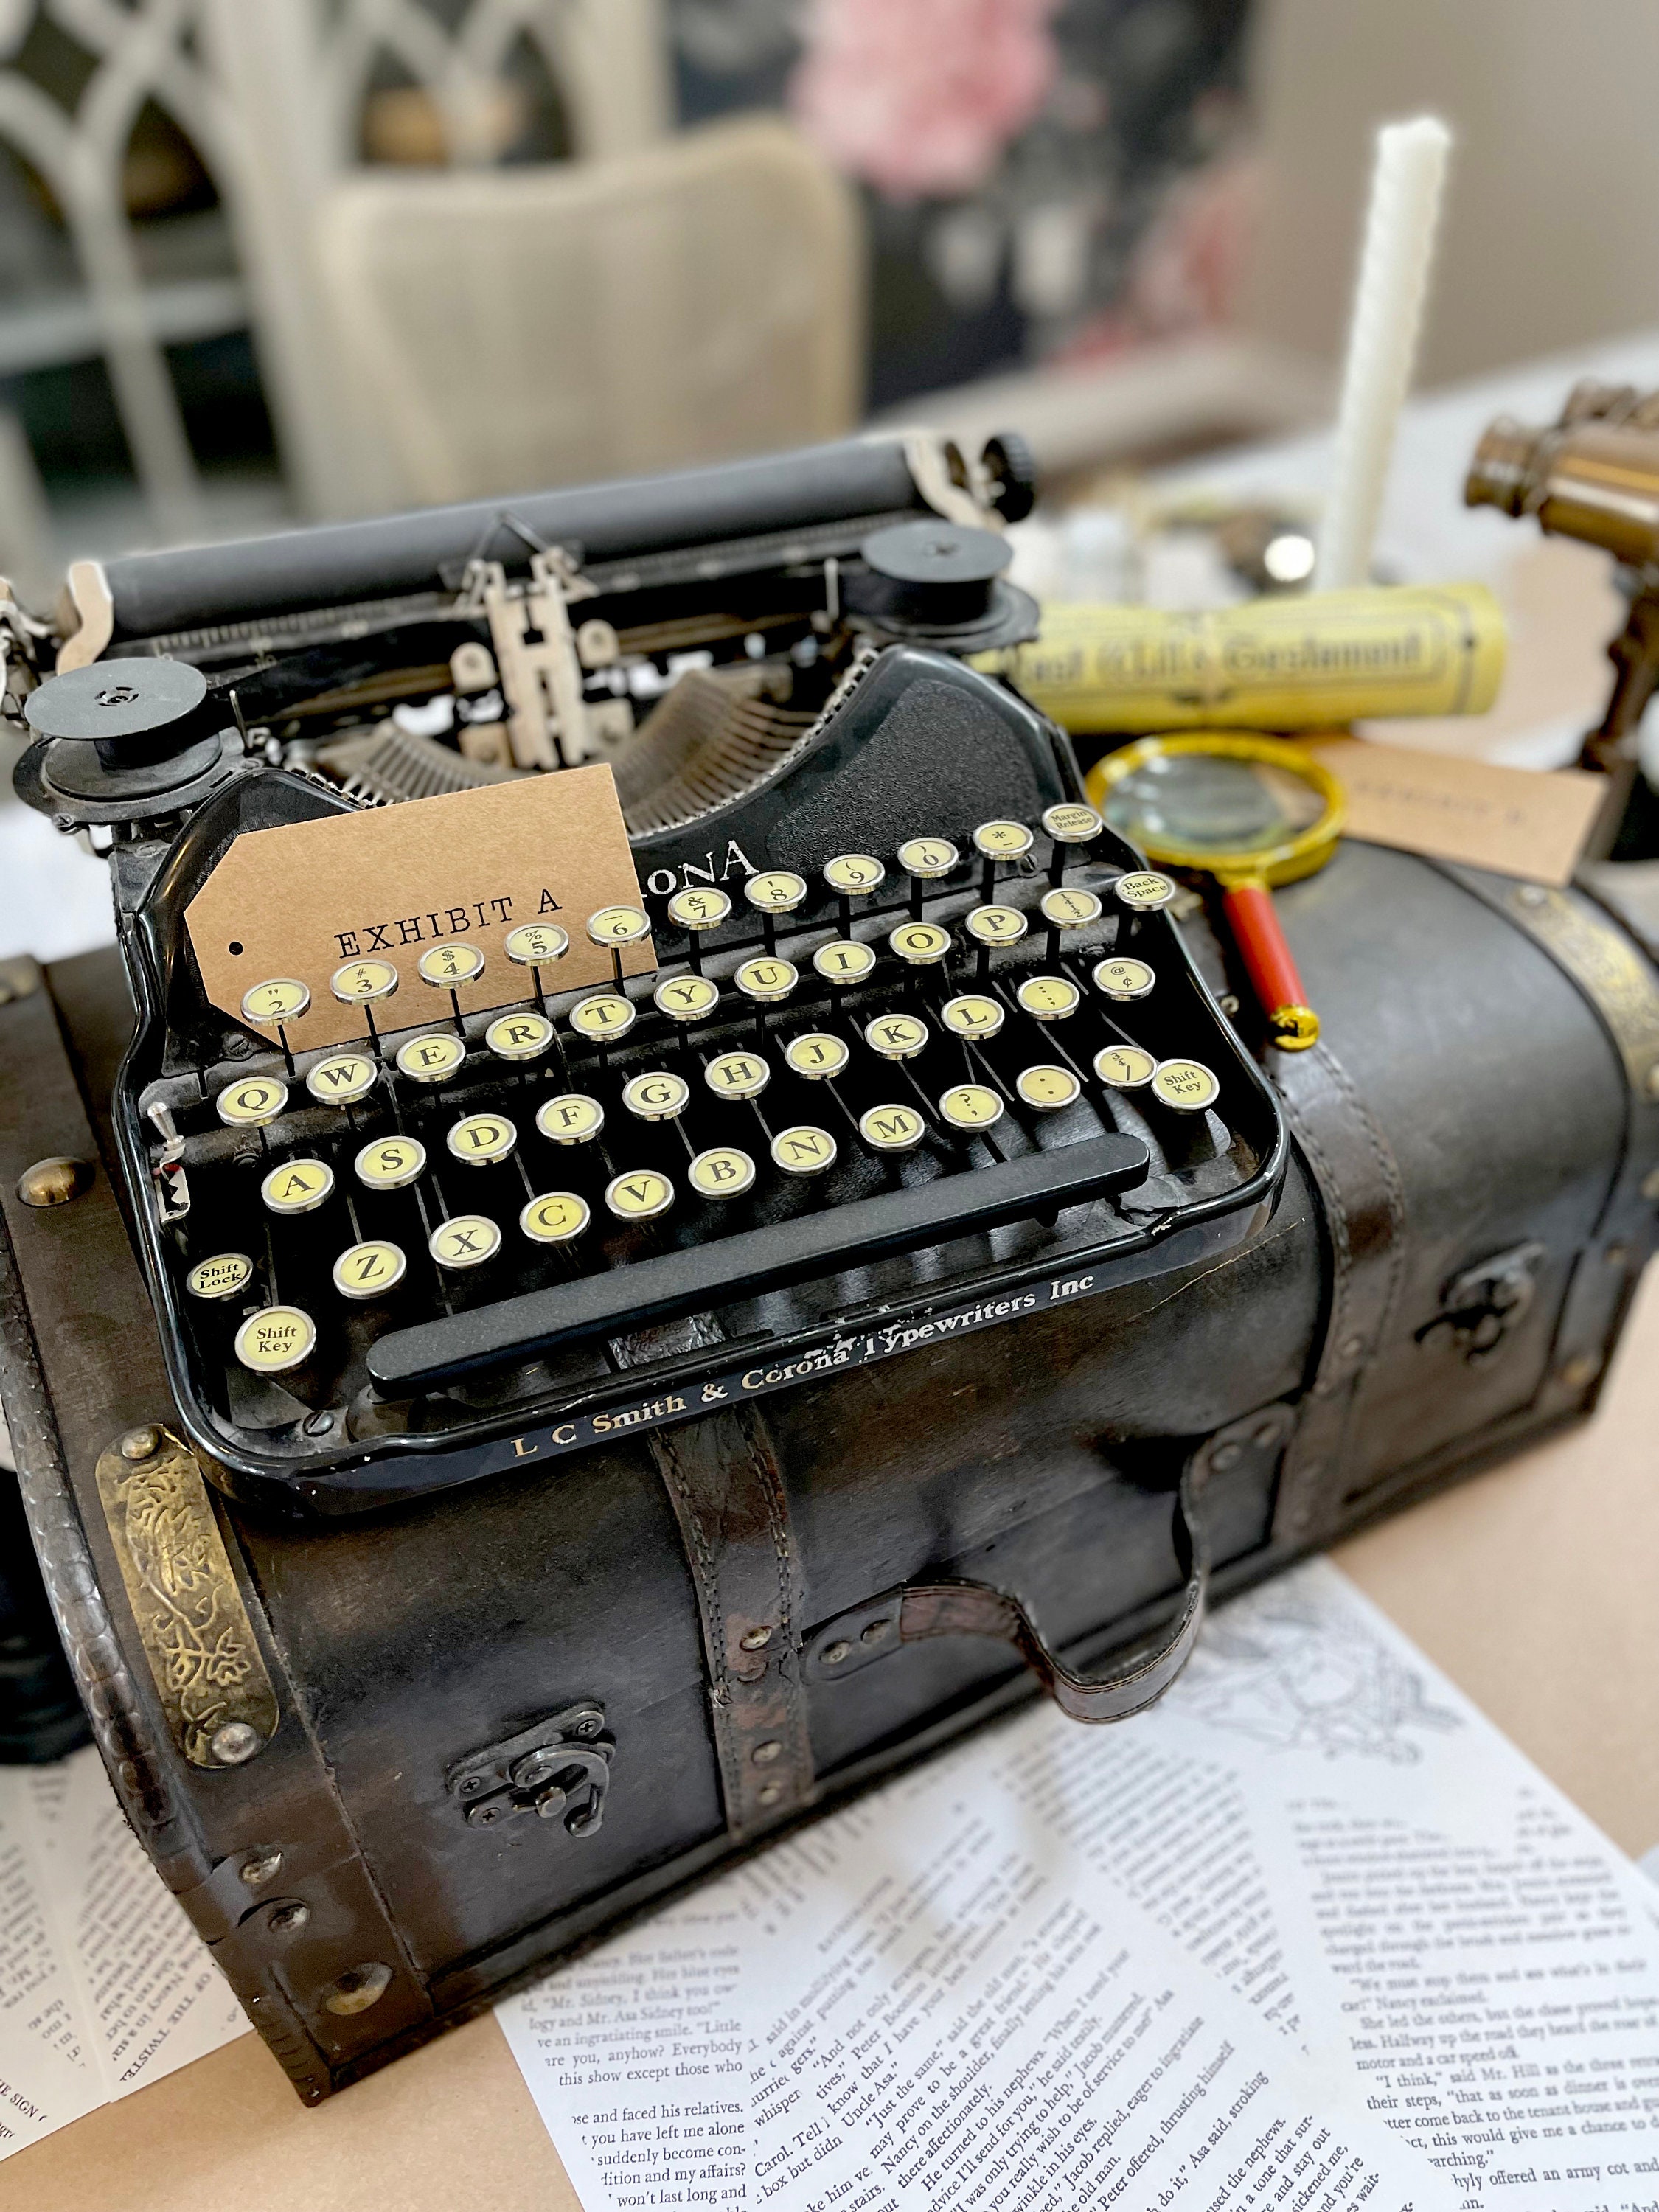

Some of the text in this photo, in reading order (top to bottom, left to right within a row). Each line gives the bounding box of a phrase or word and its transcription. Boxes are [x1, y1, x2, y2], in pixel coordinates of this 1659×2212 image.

[1051, 811, 1087, 822] Margin
[1054, 817, 1093, 829] Release
[641, 839, 759, 898] ONA
[923, 854, 939, 866] 0
[849, 872, 864, 883] 9
[1123, 877, 1159, 890] Back
[771, 889, 787, 900] 8
[1127, 885, 1166, 898] Space
[692, 906, 707, 918] 7
[334, 889, 562, 959] EXHIBIT A
[612, 922, 627, 936] 6
[984, 915, 1005, 931] P
[531, 942, 547, 954] 5
[907, 933, 933, 948] O
[443, 962, 460, 975] 4
[836, 953, 851, 970] I
[1110, 966, 1125, 975] @
[358, 980, 373, 992] 3
[750, 967, 777, 984] U
[670, 985, 696, 1004] Y
[268, 1001, 286, 1014] 2
[585, 1004, 615, 1024] T
[957, 1009, 987, 1026] L
[505, 1026, 539, 1044] R
[880, 1024, 914, 1044] K
[417, 1046, 446, 1066] E
[810, 1044, 824, 1063] J
[321, 1063, 357, 1086] W
[720, 1062, 755, 1084] H
[1164, 1071, 1197, 1086] Shift
[641, 1084, 670, 1103] G
[1172, 1082, 1200, 1094] Key
[237, 1090, 268, 1110] Q
[557, 1106, 580, 1127] F
[873, 1114, 910, 1137] M
[467, 1127, 499, 1148] D
[381, 1149, 403, 1170] S
[790, 1137, 820, 1161] N
[712, 1161, 737, 1182] B
[282, 1175, 314, 1197] A
[622, 1180, 650, 1202] V
[538, 1205, 566, 1226] C
[449, 1230, 482, 1256] X
[200, 1264, 239, 1279] Shift
[357, 1254, 384, 1280] Z
[200, 1273, 242, 1289] Lock
[257, 1326, 297, 1339] Shift
[259, 1341, 293, 1352] Key
[510, 1438, 538, 1457] L
[552, 1425, 577, 1444] C
[592, 1395, 687, 1434] Smith
[701, 1383, 728, 1402] &
[741, 1349, 849, 1391] Corona
[1049, 1274, 1093, 1301] Inc
[120, 2028, 170, 2081] TWISTE
[608, 2039, 742, 2064] anyhow? Everybody
[559, 2059, 742, 2086] this show except those who
[896, 2079, 915, 2099] the
[10, 2093, 39, 2118] SIGN
[593, 2101, 743, 2123] and faced his relatives.
[840, 2091, 876, 2127] Uncle
[881, 2051, 995, 2174] Nancy on the shoulder,
[1415, 2104, 1568, 2128] come back to the tenant
[921, 2050, 1047, 2191] He turned to his nephews.
[925, 2084, 992, 2158] affectionately.
[1189, 2070, 1269, 2168] Asa said, stroking
[591, 2122, 745, 2149] you have left me alone
[975, 2132, 1000, 2163] send
[995, 2116, 1015, 2138] for
[1054, 2118, 1097, 2164] his eyes.
[1275, 2115, 1313, 2165] that sur-
[1433, 2126, 1563, 2146] this would give me
[597, 2145, 746, 2166] suddenly become con-
[754, 2121, 824, 2177] Carol. Tell
[985, 2155, 1009, 2185] only
[1006, 2121, 1041, 2158] trying
[1034, 2109, 1049, 2122] to
[1009, 2126, 1061, 2188] really wish
[1062, 2109, 1130, 2191] Jacob replied,
[1097, 2084, 1206, 2211] Peter offered, thrusting
[1228, 2118, 1286, 2188] the nephews.
[1293, 2127, 1331, 2177] stay out
[645, 2162, 746, 2184] and my affairs?
[762, 2135, 843, 2198] box but didn
[1489, 2162, 1629, 2185] offered an army cot
[1079, 2155, 1121, 2205] old man.
[1292, 2145, 1348, 2212] sickened me,
[660, 2190, 683, 2203] last
[687, 2188, 717, 2204] long
[721, 2184, 746, 2199] and
